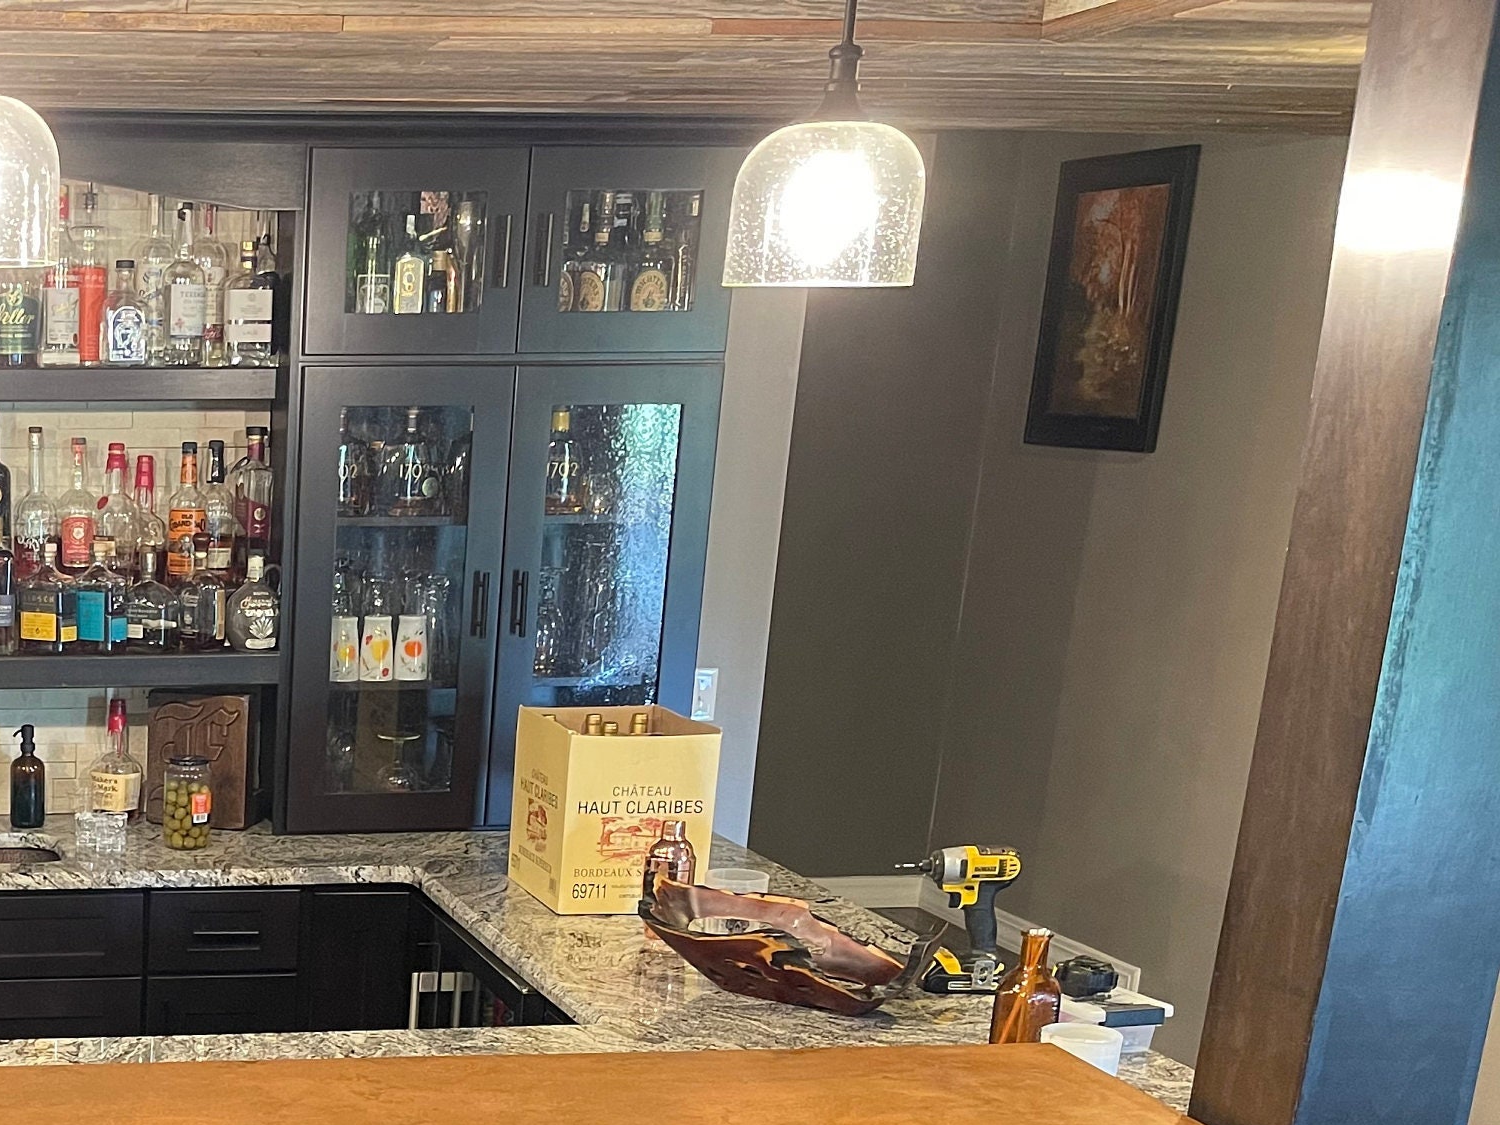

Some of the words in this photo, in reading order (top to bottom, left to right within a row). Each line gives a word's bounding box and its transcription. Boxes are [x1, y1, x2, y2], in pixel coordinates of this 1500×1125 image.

[612, 784, 672, 797] CHÂTEAU
[577, 800, 621, 815] HAUT
[626, 800, 704, 814] CLARIBES
[573, 868, 632, 878] BORDEAUX
[636, 869, 643, 877] S
[572, 883, 607, 899] 69711
